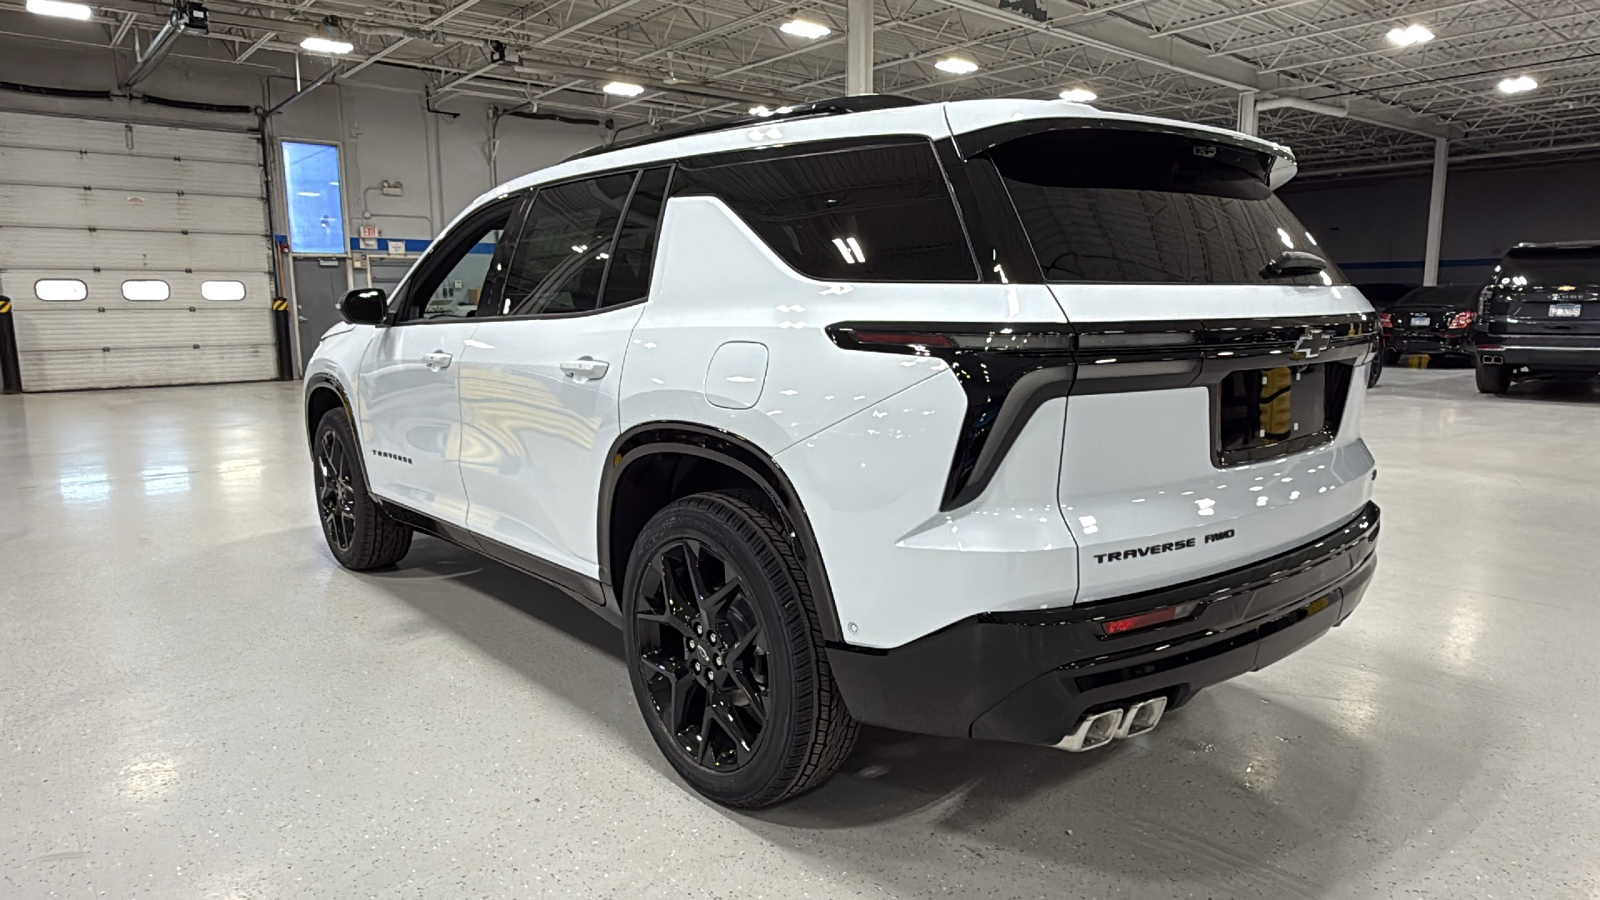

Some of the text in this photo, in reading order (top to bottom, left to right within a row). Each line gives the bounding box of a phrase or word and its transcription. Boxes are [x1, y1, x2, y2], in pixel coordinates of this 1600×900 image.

[372, 449, 413, 465] TRAVERSE
[1093, 528, 1235, 564] TRAVERSE AWD
